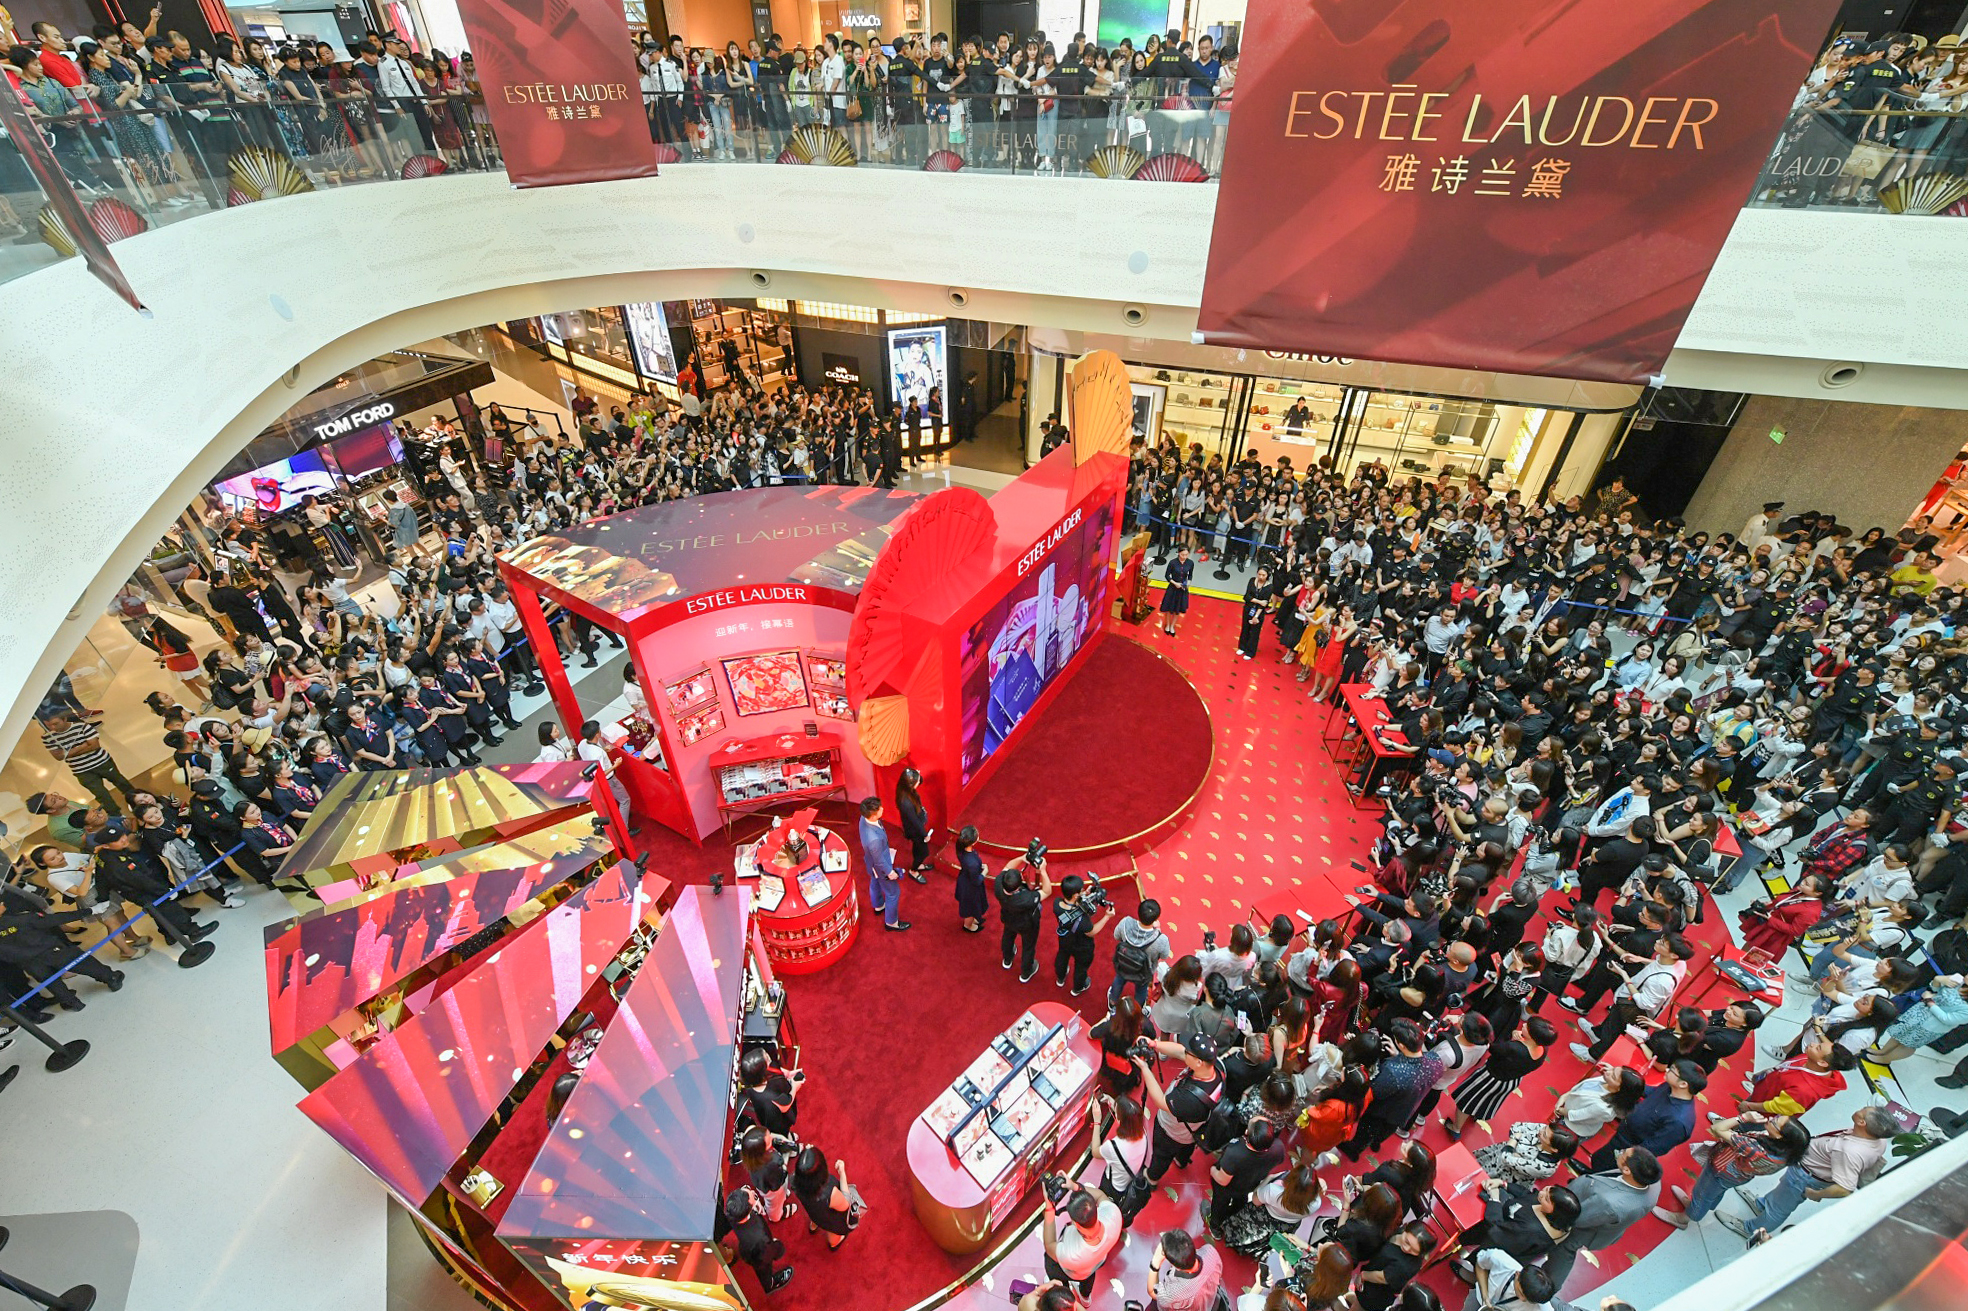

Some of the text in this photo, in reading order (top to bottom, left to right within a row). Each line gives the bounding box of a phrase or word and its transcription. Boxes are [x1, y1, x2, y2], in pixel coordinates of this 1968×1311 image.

[561, 83, 629, 102] LAUDER
[546, 104, 602, 120] 雅诗兰黛
[1461, 93, 1719, 150] LAUDER
[1378, 153, 1572, 199] 雅诗兰黛
[825, 370, 859, 382] COACH
[314, 402, 394, 440] TOM FORD
[736, 522, 850, 545] LAUDER
[1047, 508, 1083, 550] LAUDER
[740, 587, 807, 603] LAUDER
[562, 1252, 678, 1266] 新年快乐
